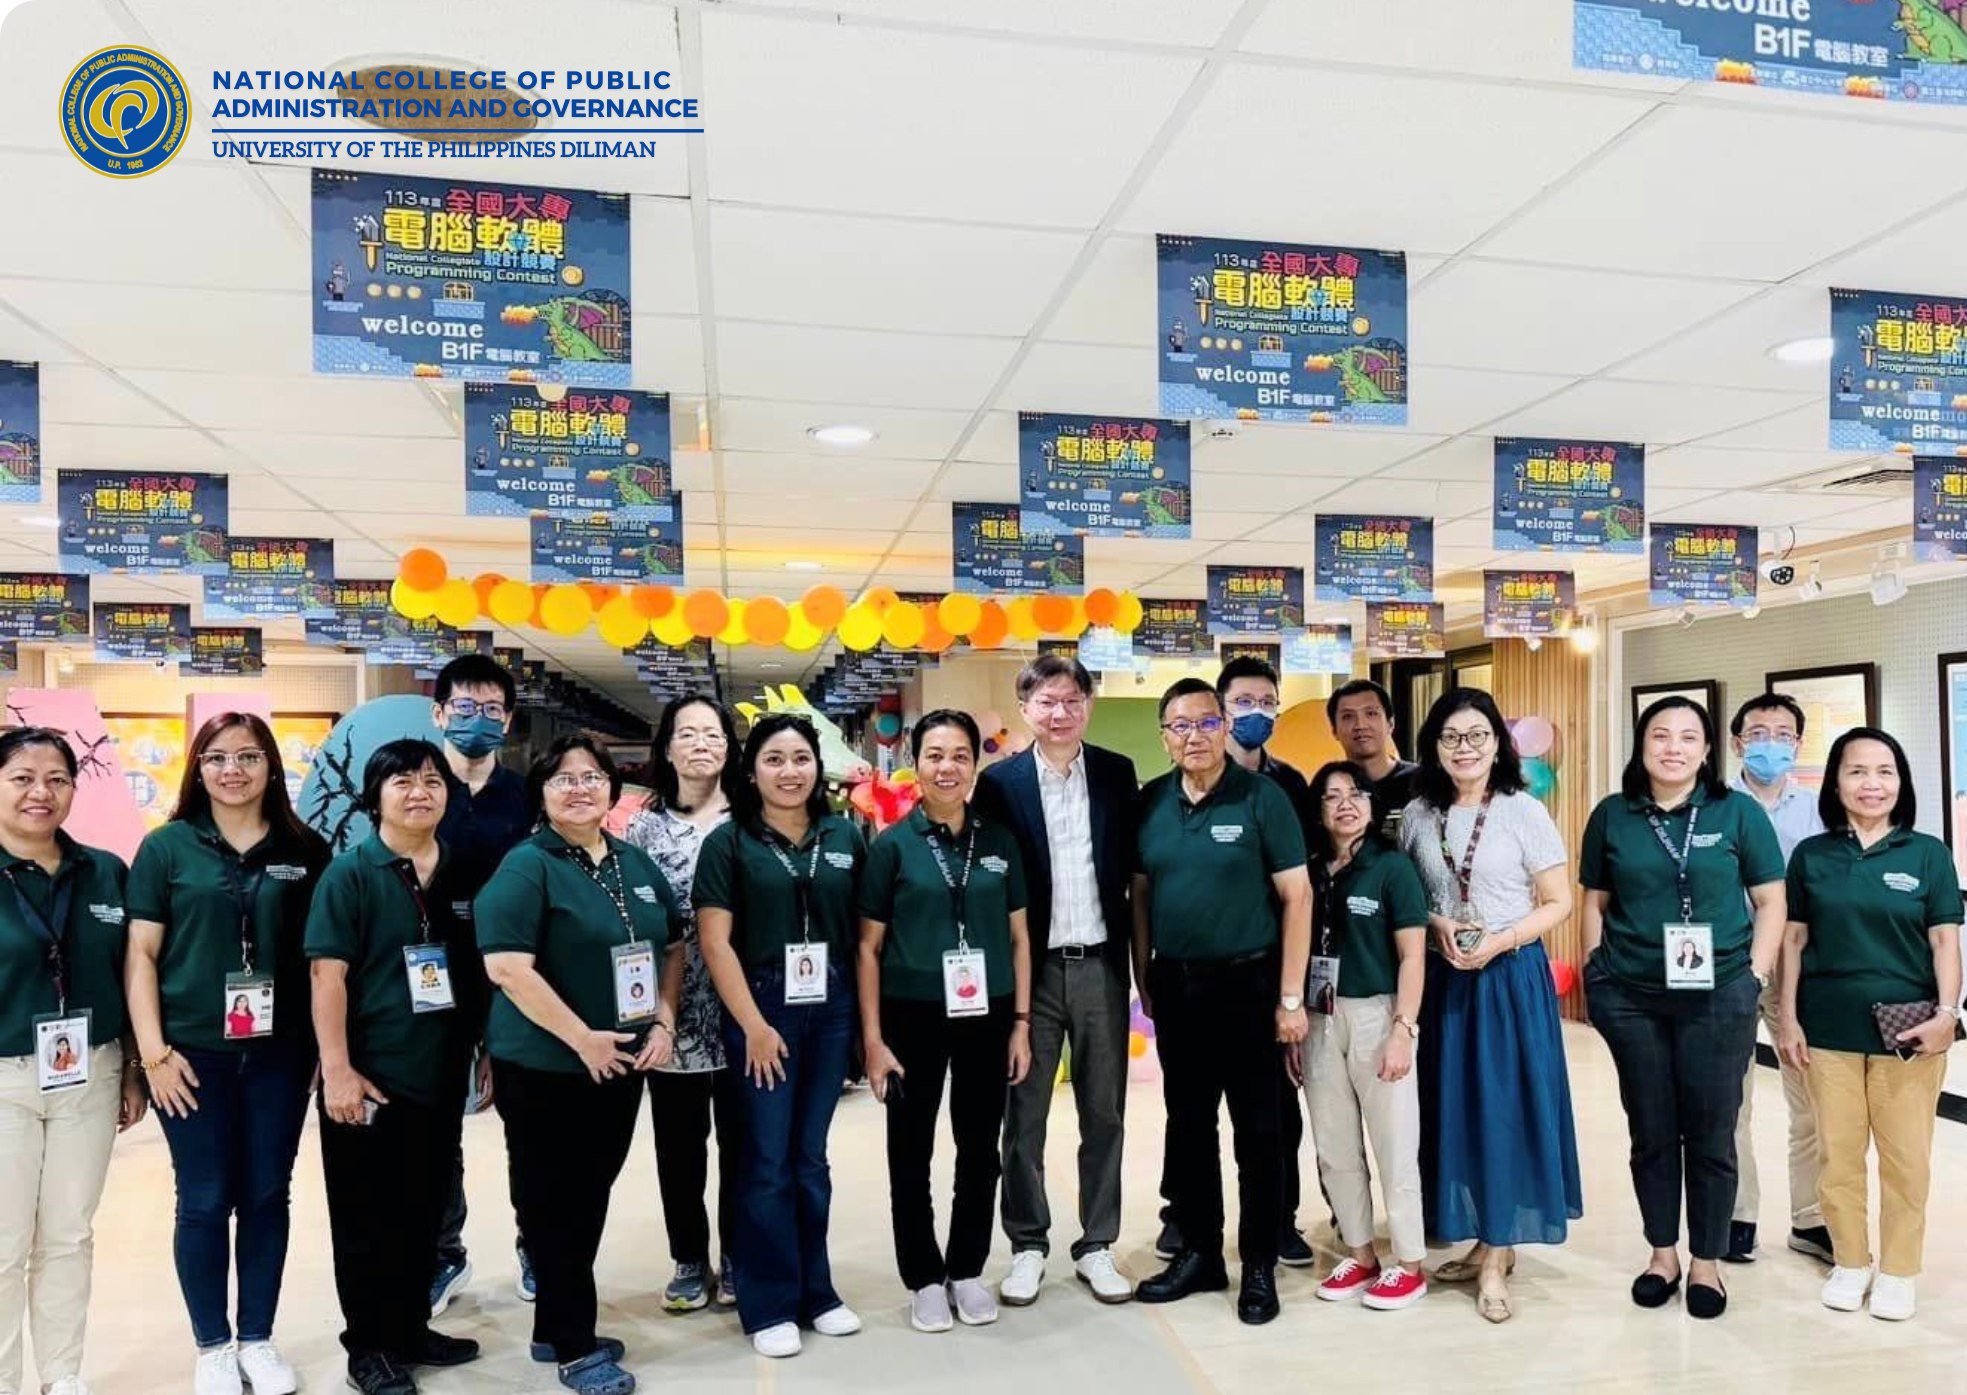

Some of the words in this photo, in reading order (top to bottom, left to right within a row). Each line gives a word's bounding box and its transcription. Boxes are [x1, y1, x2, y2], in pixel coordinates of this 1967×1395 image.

[1648, 0, 1811, 21] come
[1754, 23, 1811, 58] B1F
[1814, 38, 1889, 67] 電腦教室
[384, 208, 564, 259] 電腦軟體
[386, 261, 492, 282] Programming
[496, 269, 557, 284] Contest
[1213, 268, 1355, 311] 電腦軟體
[361, 316, 484, 339] welcome
[1215, 318, 1297, 334] Programming
[1300, 322, 1349, 335] Contest
[1876, 319, 1967, 355] 電腦軟
[441, 342, 484, 362] B1F
[1195, 365, 1291, 385] welcome
[1877, 361, 1946, 376] Programming
[1257, 388, 1291, 406] B1F
[1862, 403, 1940, 421] welcome
[496, 477, 576, 492] welcome
[548, 494, 576, 507] B1F
[1046, 499, 1111, 513] welcome
[1088, 514, 1110, 526] B1F
[1515, 518, 1574, 530] welcome
[85, 543, 150, 554] welcome
[553, 554, 613, 566] welcome
